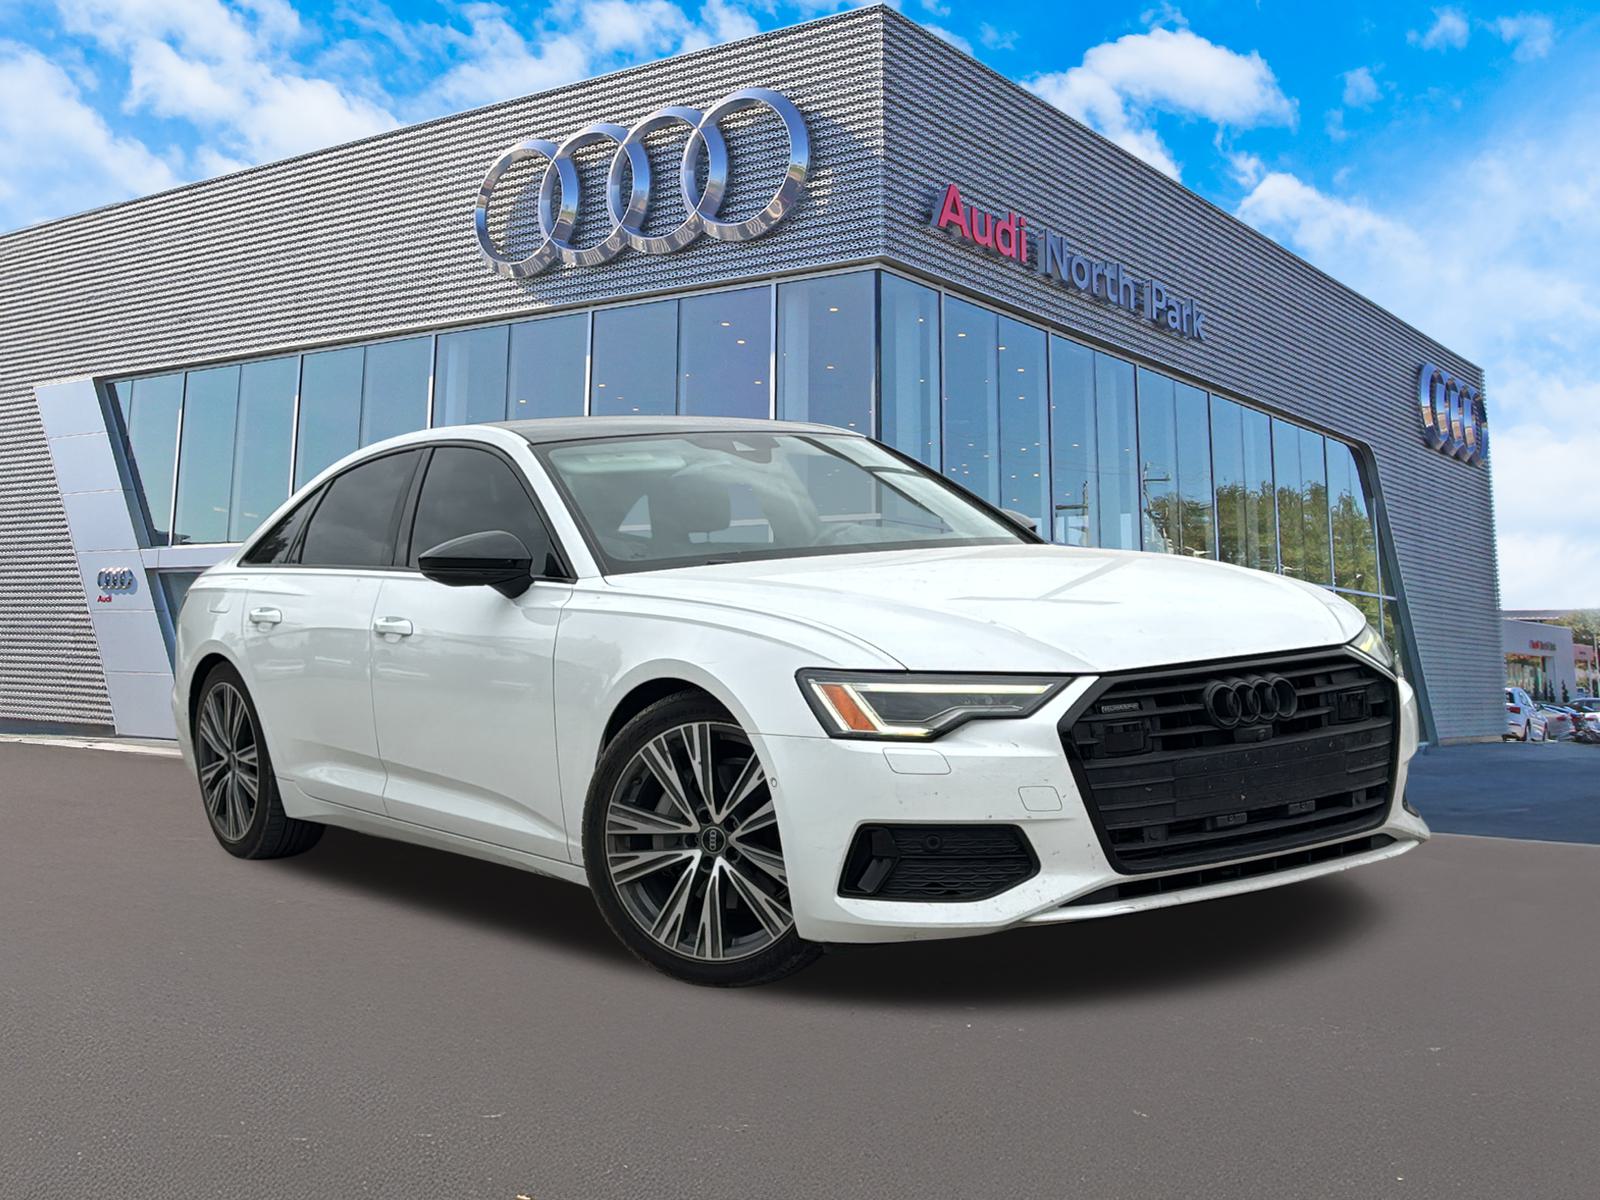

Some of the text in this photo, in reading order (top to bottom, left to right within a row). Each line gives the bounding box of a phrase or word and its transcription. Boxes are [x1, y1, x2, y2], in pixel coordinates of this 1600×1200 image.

[933, 183, 1207, 340] Audi North Park
